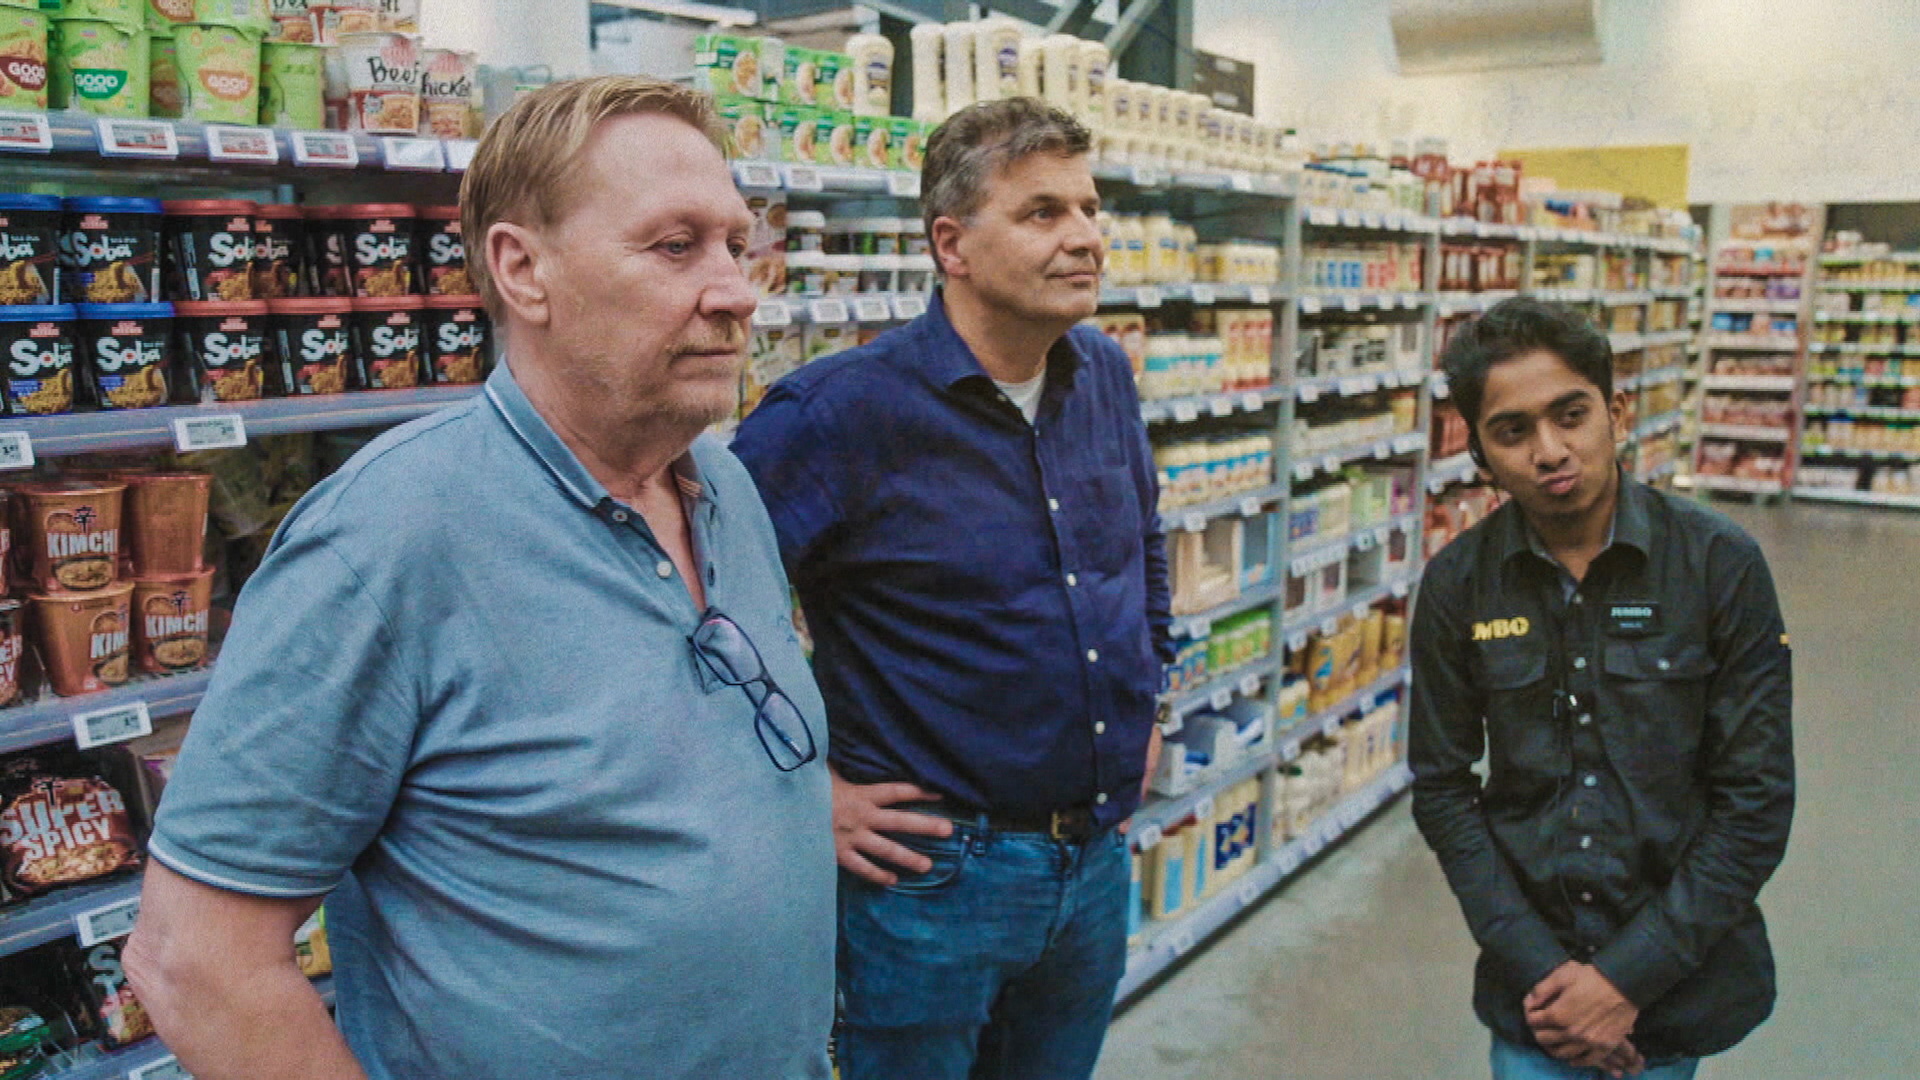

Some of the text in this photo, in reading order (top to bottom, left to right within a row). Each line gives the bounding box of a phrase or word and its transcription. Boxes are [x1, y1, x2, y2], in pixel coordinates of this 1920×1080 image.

[75, 73, 119, 89] GOOD
[207, 74, 249, 92] GOOD
[366, 56, 419, 84] Beef
[9, 338, 73, 376] Soba
[96, 336, 161, 372] Soba
[1471, 616, 1530, 641] MBO
[0, 789, 125, 845] SUPER
[16, 817, 111, 875] SPICY
